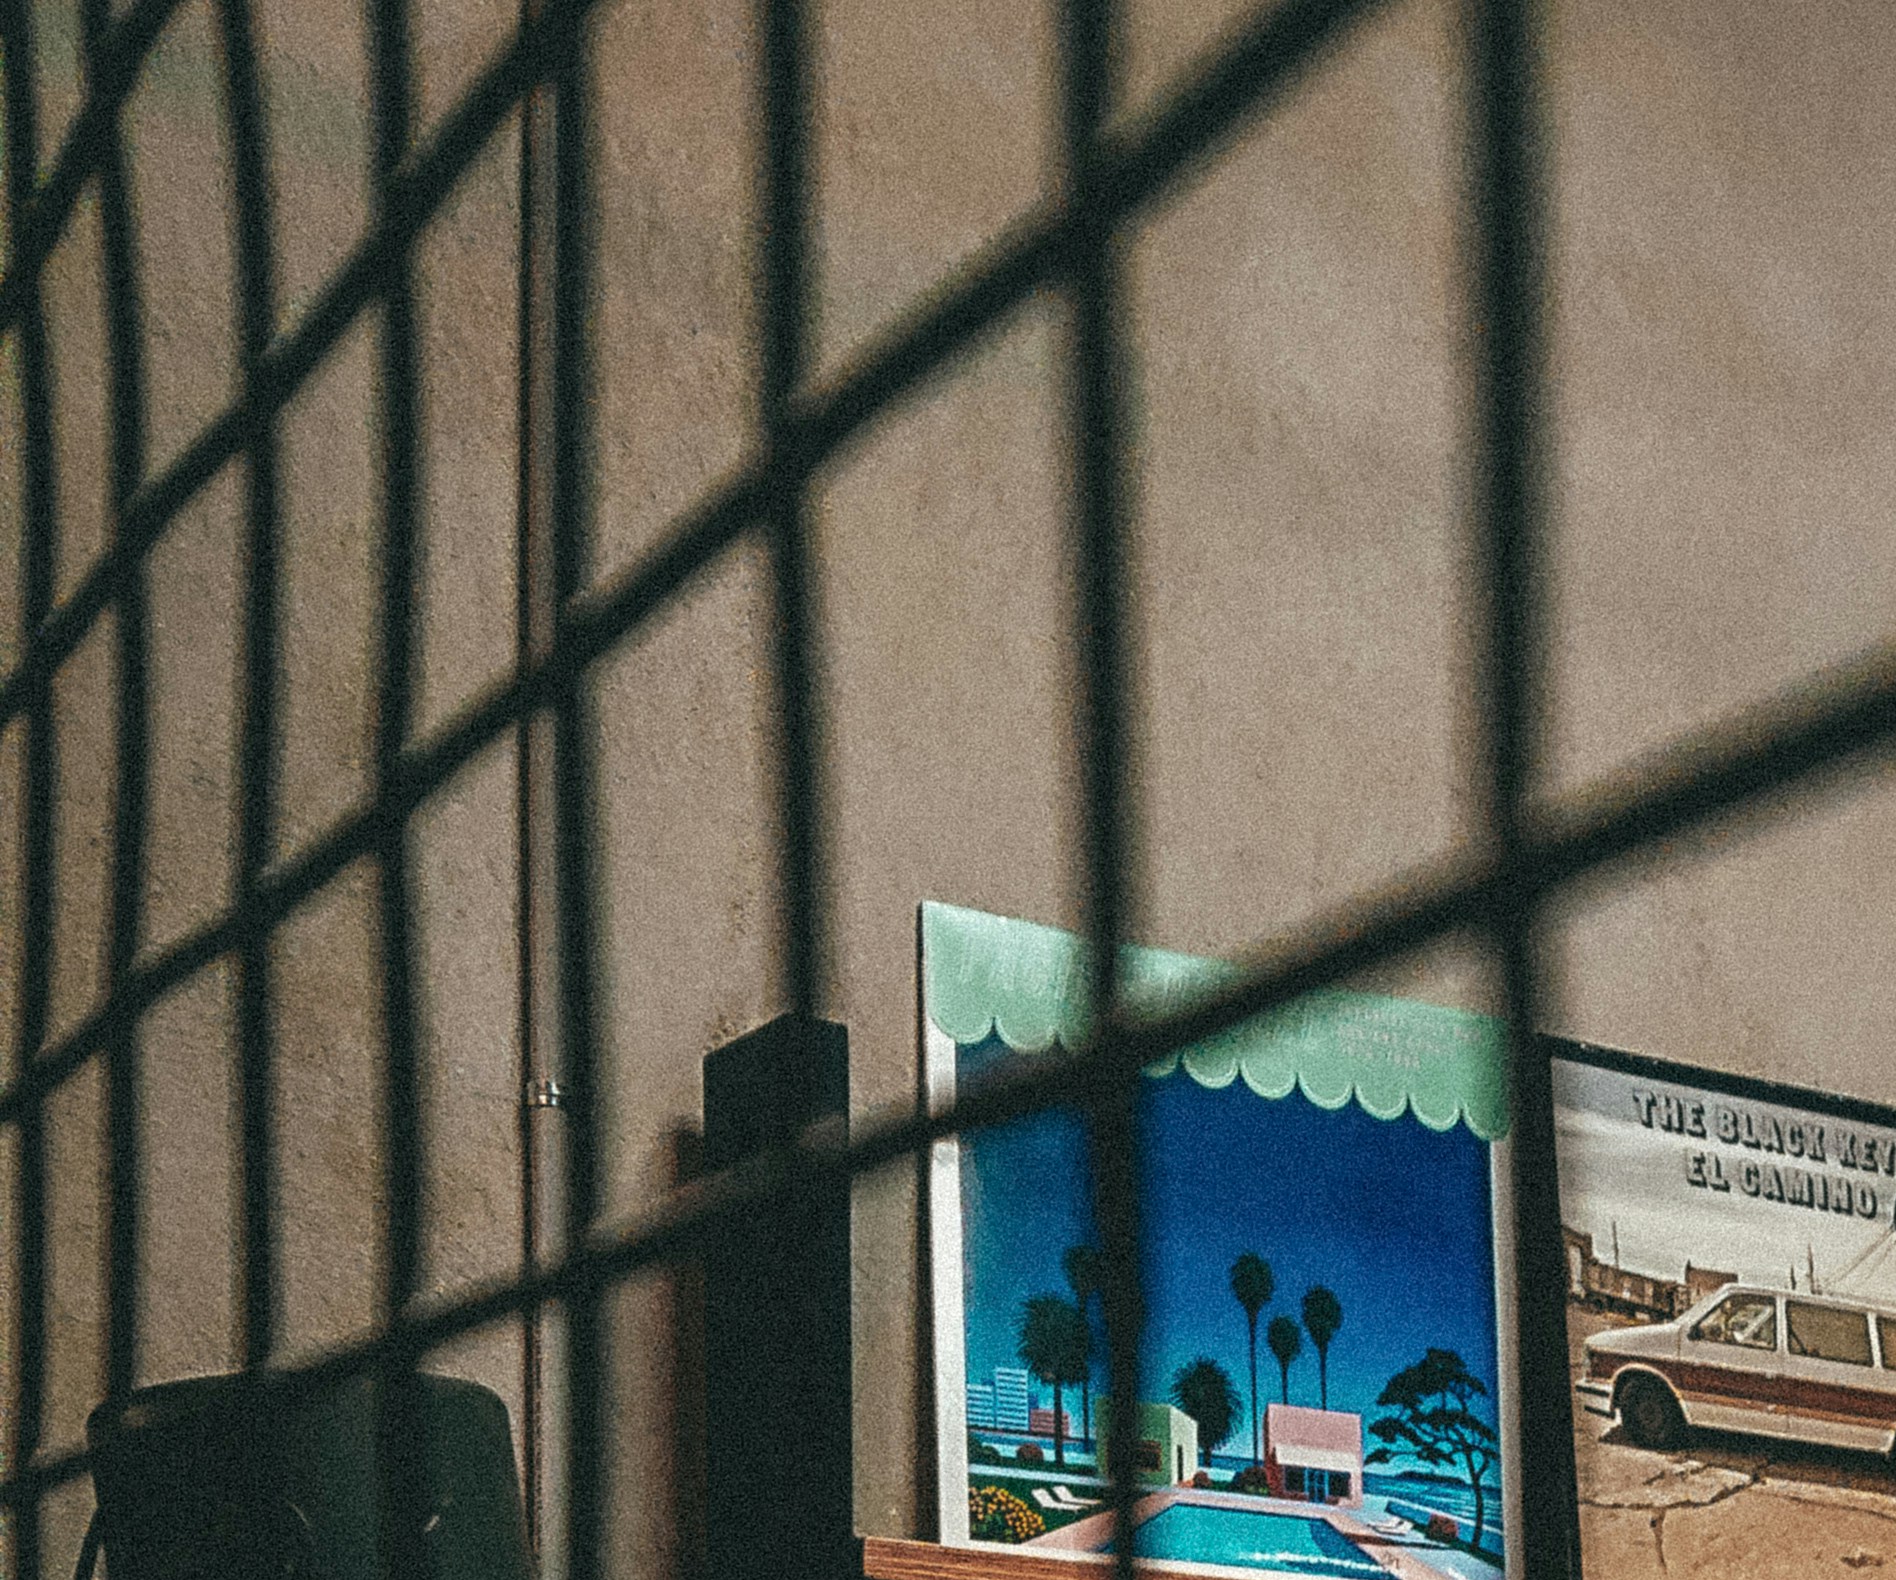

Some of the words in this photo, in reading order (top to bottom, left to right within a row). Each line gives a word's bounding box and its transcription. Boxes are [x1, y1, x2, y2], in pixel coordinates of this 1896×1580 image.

[1633, 1088, 1707, 1140] THE
[1716, 1104, 1827, 1164] BLACK
[1685, 1149, 1731, 1193] EL
[1738, 1157, 1879, 1220] CAMINO
